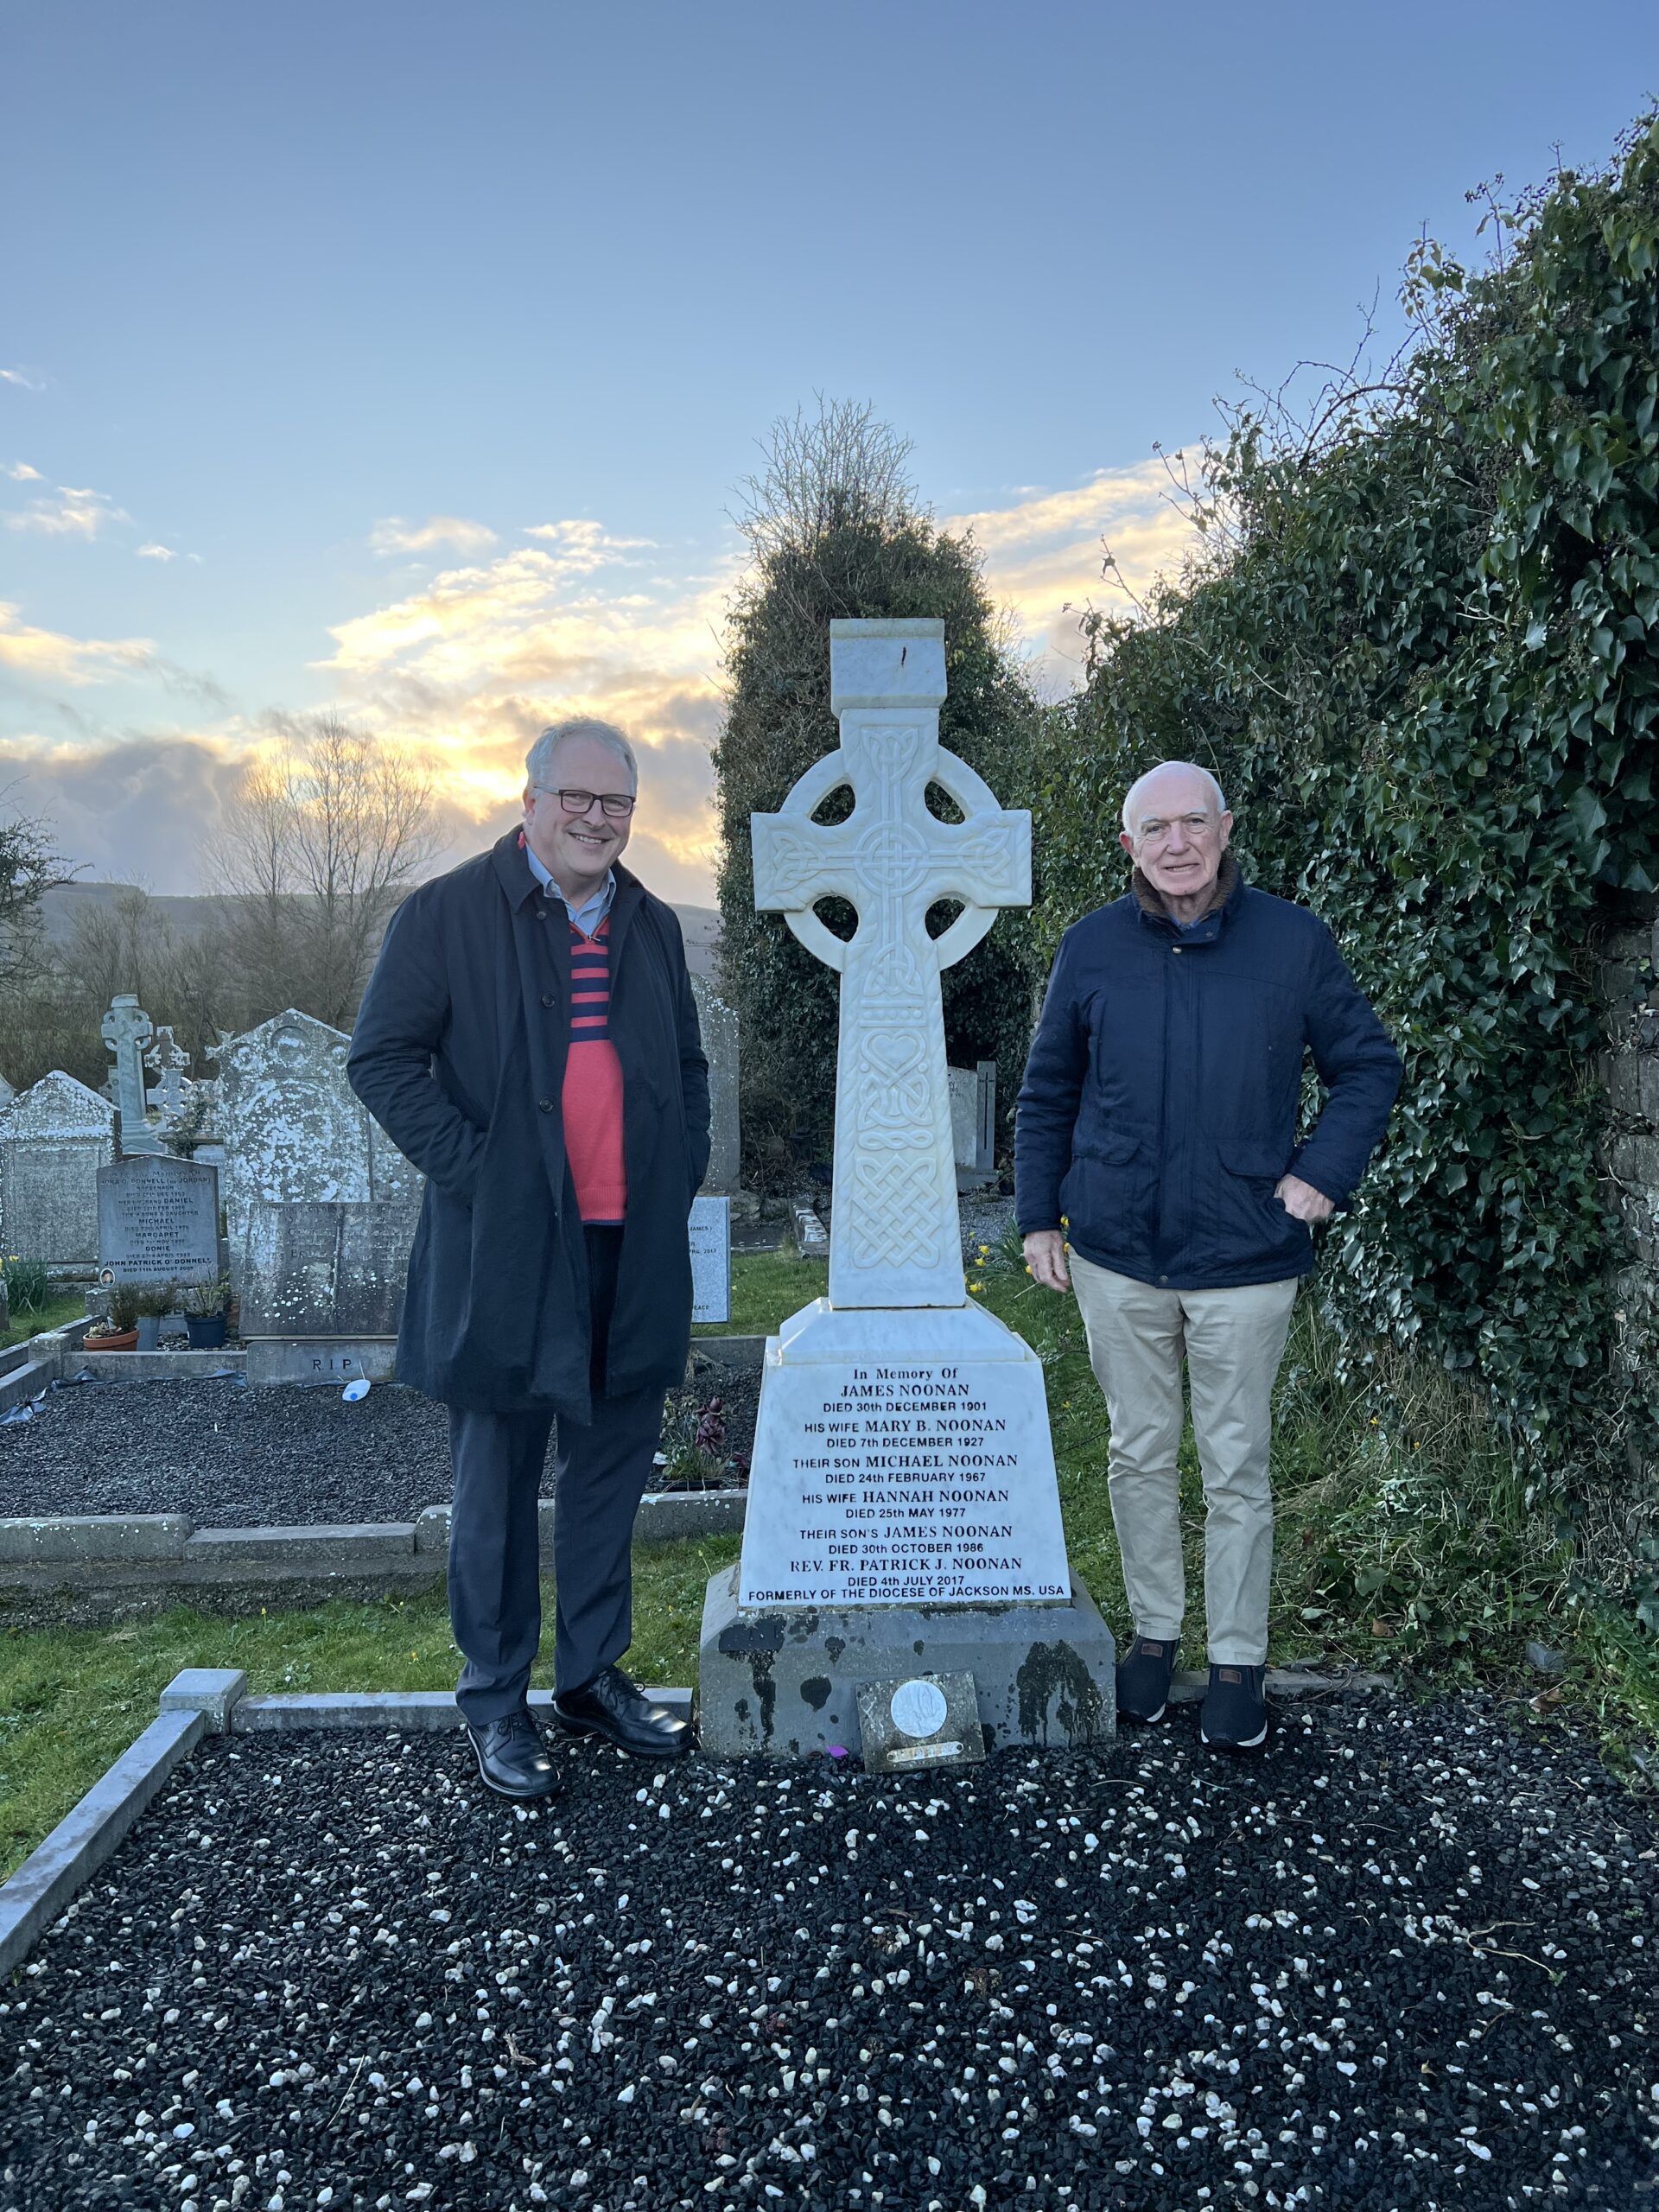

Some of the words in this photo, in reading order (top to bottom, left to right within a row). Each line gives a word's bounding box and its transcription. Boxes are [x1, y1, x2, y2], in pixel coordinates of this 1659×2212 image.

[855, 1370, 867, 1379] In
[877, 1369, 932, 1381] Memory
[942, 1368, 957, 1378] Of
[841, 1385, 893, 1396] JAMES
[900, 1384, 969, 1395] NOONAN
[823, 1403, 852, 1412] DIED
[857, 1403, 881, 1412] 30th
[887, 1402, 956, 1412] DECEMBER
[962, 1402, 986, 1411] 1901
[805, 1423, 824, 1433] HIS
[829, 1423, 859, 1433] WIFE
[866, 1421, 911, 1432] MARY
[917, 1421, 930, 1431] B.
[937, 1420, 1005, 1431] NOONAN
[827, 1439, 856, 1447] DIED
[861, 1439, 878, 1447] 7th
[883, 1438, 952, 1447] DECEMBER
[958, 1438, 983, 1446] 1927
[793, 1459, 830, 1468] THEIR
[834, 1459, 859, 1468] SON
[867, 1455, 943, 1467] MICHAEL
[949, 1455, 1017, 1466] NOONAN
[826, 1474, 855, 1483] DIED
[859, 1474, 884, 1483] 24th
[888, 1473, 954, 1482] FEBRUARY
[960, 1472, 985, 1482] 1967
[803, 1495, 823, 1503] HIS
[827, 1494, 855, 1503] WIFE
[863, 1491, 933, 1503] HANNAH
[940, 1491, 1008, 1502] NOONAN
[846, 1509, 874, 1518] DIED
[880, 1509, 904, 1518] 25th
[909, 1509, 934, 1517] MAY
[940, 1508, 965, 1517] 1977
[800, 1529, 836, 1539] THEIR
[841, 1529, 878, 1538] SON'S
[884, 1527, 937, 1538] JAMES
[943, 1526, 1012, 1537] NOONAN
[829, 1545, 857, 1554] DIED
[862, 1545, 887, 1554] 30th
[892, 1543, 951, 1553] OCTOBER
[957, 1543, 983, 1552] 1986
[791, 1560, 823, 1572] REV.
[830, 1560, 854, 1571] FR.
[861, 1559, 930, 1571] PATRICK
[935, 1559, 946, 1570] J.
[953, 1558, 1021, 1569] NOONAN
[849, 1577, 877, 1586] DIED
[881, 1577, 899, 1586] 4th
[904, 1576, 933, 1586] JULY
[938, 1576, 964, 1585] 2017
[749, 1590, 816, 1601] FORMERLY
[821, 1589, 836, 1599] OF
[842, 1589, 865, 1599] THE
[870, 1588, 925, 1598] DIOCESE
[931, 1587, 945, 1597] OF
[950, 1586, 1009, 1597] JACKSON
[1014, 1586, 1035, 1596] MS.
[1039, 1586, 1064, 1595] USA
